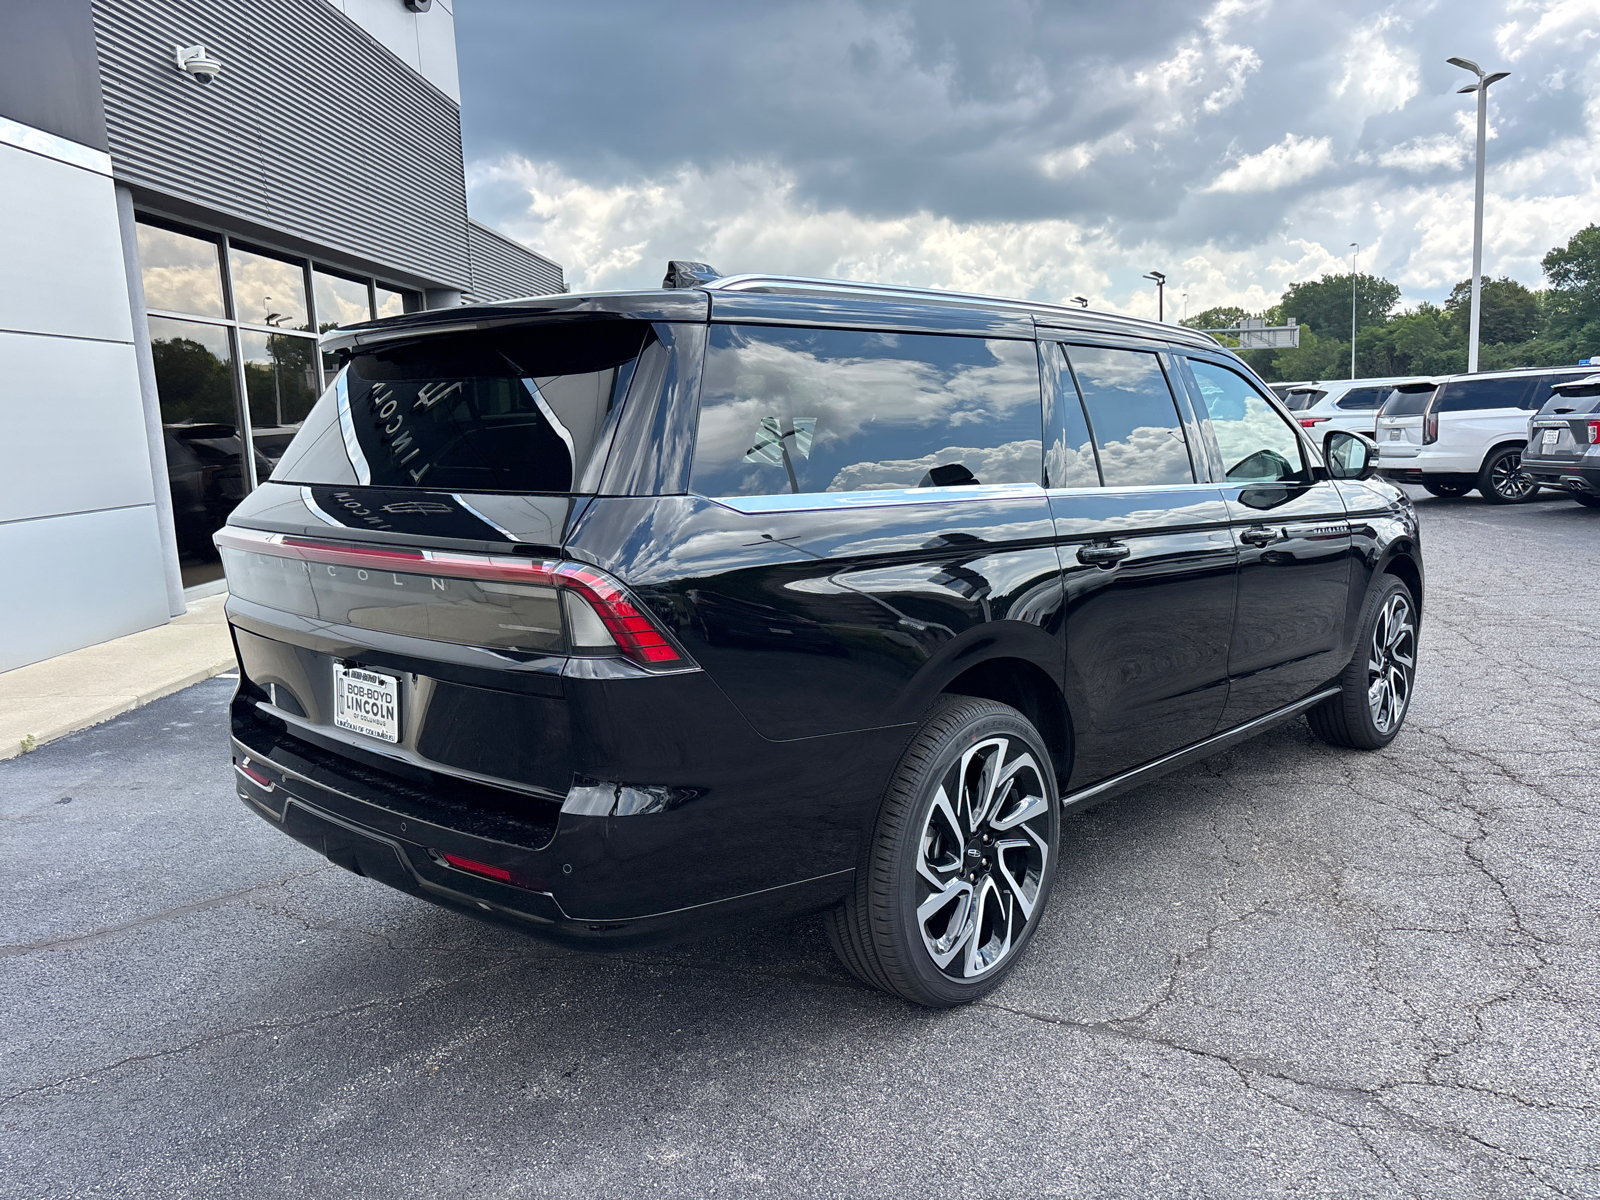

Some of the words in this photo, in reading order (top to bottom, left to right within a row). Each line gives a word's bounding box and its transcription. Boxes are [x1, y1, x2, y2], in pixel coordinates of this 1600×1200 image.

[258, 554, 446, 591] LINCOLN
[347, 683, 393, 704] BOB-BOYD
[347, 695, 394, 721] LINCOLN
[360, 714, 387, 727] COLUMBUS
